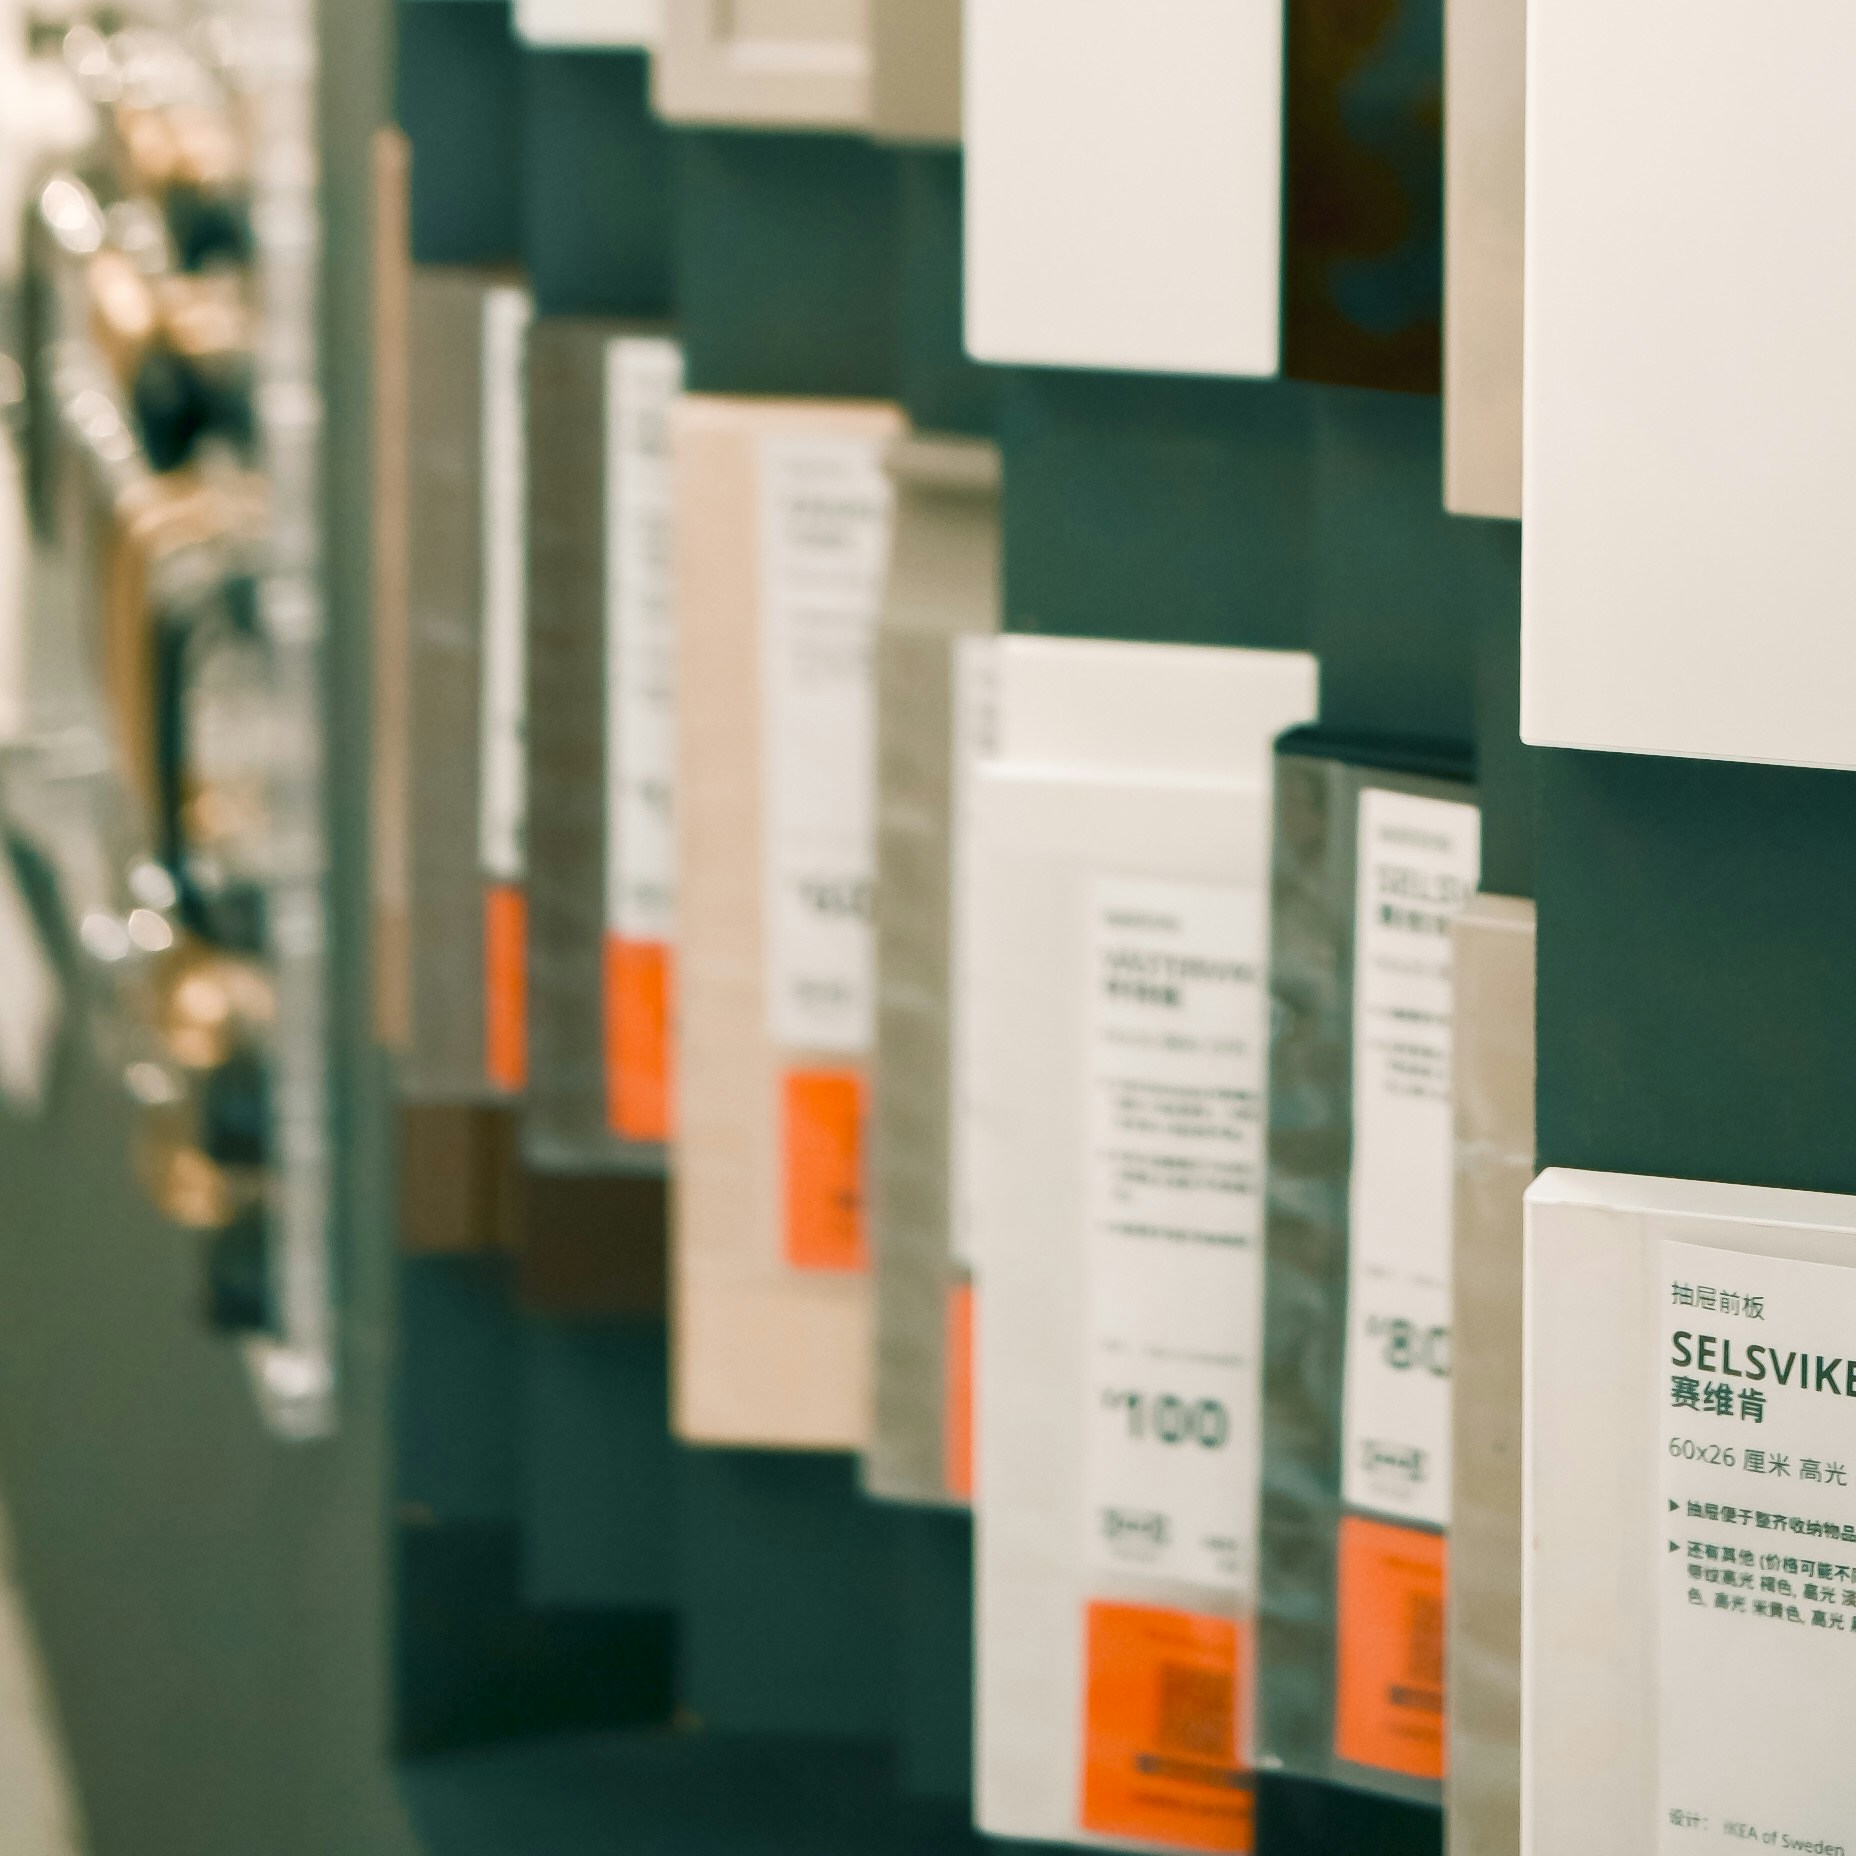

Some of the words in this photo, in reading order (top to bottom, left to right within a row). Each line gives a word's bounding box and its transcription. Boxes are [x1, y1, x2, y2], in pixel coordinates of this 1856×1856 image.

[1671, 1280, 1765, 1321] 抽屉前板
[1671, 1375, 1767, 1423] 赛维肯
[1668, 1438, 1736, 1467] 60x26
[1743, 1448, 1791, 1478] 厘米
[1799, 1458, 1848, 1487] 高光
[1762, 1831, 1777, 1845] of
[1781, 1834, 1845, 1856] Sweden
